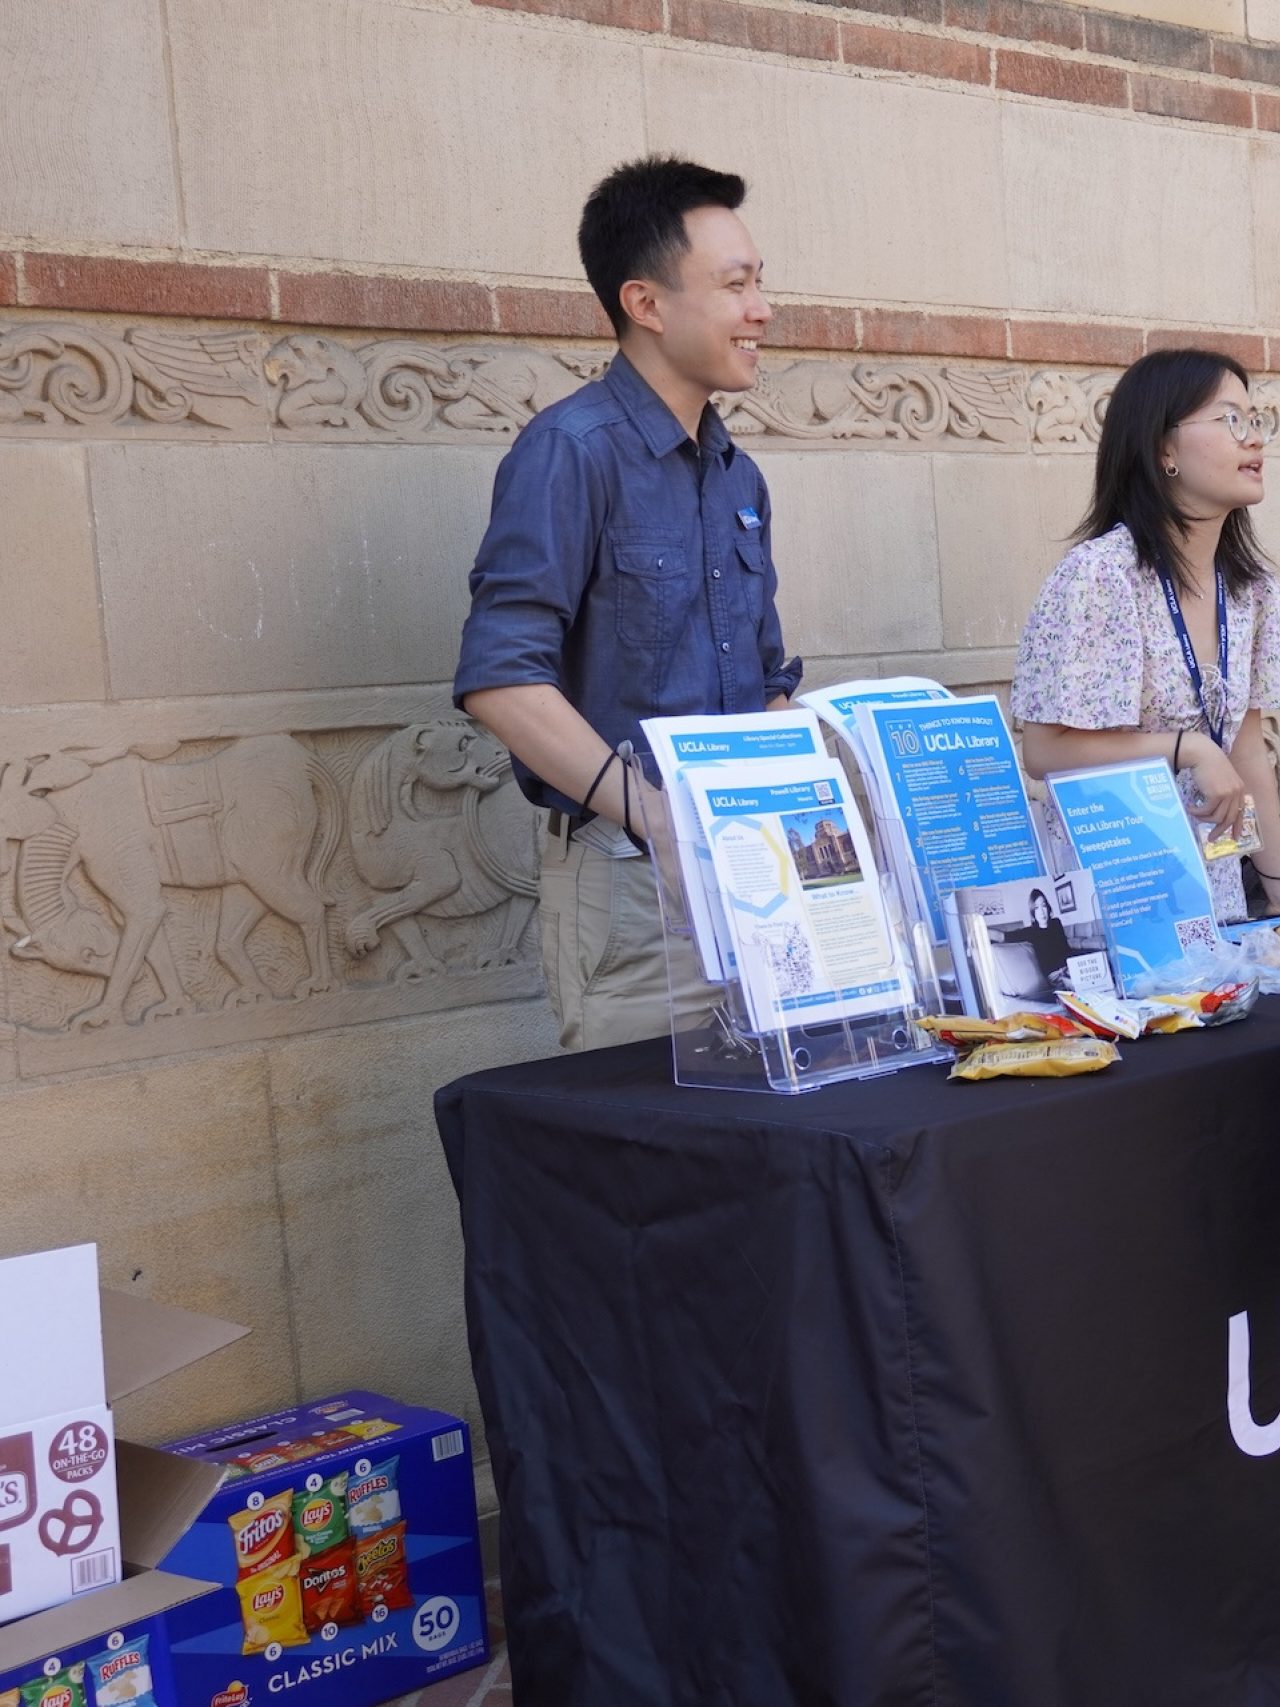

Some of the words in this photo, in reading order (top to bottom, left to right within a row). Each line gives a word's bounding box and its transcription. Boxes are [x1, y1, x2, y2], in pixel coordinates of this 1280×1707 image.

[678, 742, 707, 753] UCLA
[707, 743, 730, 754] Library
[890, 730, 920, 755] 10
[923, 732, 965, 752] UCLA
[965, 736, 999, 749] Library
[713, 796, 738, 808] UCLA
[738, 798, 759, 809] Library
[1067, 807, 1089, 817] Enter
[1089, 803, 1104, 813] the
[1073, 823, 1096, 835] UCLA
[1096, 819, 1124, 831] Library
[1124, 816, 1144, 825] Tour
[1080, 837, 1131, 854] Sweepstakes
[58, 1425, 97, 1455] 48
[209, 1415, 297, 1445] CLASSIC
[52, 1449, 105, 1470] ON-THE-GO
[359, 1463, 367, 1473] 6
[66, 1465, 94, 1480] PACKS
[310, 1478, 318, 1488] 4
[348, 1475, 389, 1504] RUFFLES
[0, 1480, 19, 1507] 'S
[252, 1496, 261, 1507] 8
[303, 1501, 332, 1525] Lay's
[239, 1508, 284, 1555] Fritos
[357, 1538, 397, 1575] Cheetos
[303, 1564, 346, 1590] Doritos
[254, 1583, 283, 1610] Lay's
[375, 1607, 387, 1619] 16
[419, 1605, 454, 1637] 50
[111, 1635, 120, 1646] 6
[323, 1624, 337, 1638] 10
[268, 1646, 277, 1657] 6
[47, 1661, 56, 1671] 4
[100, 1652, 141, 1681] RUFFLES
[268, 1648, 356, 1693] CLASSIC
[361, 1631, 399, 1660] MIX
